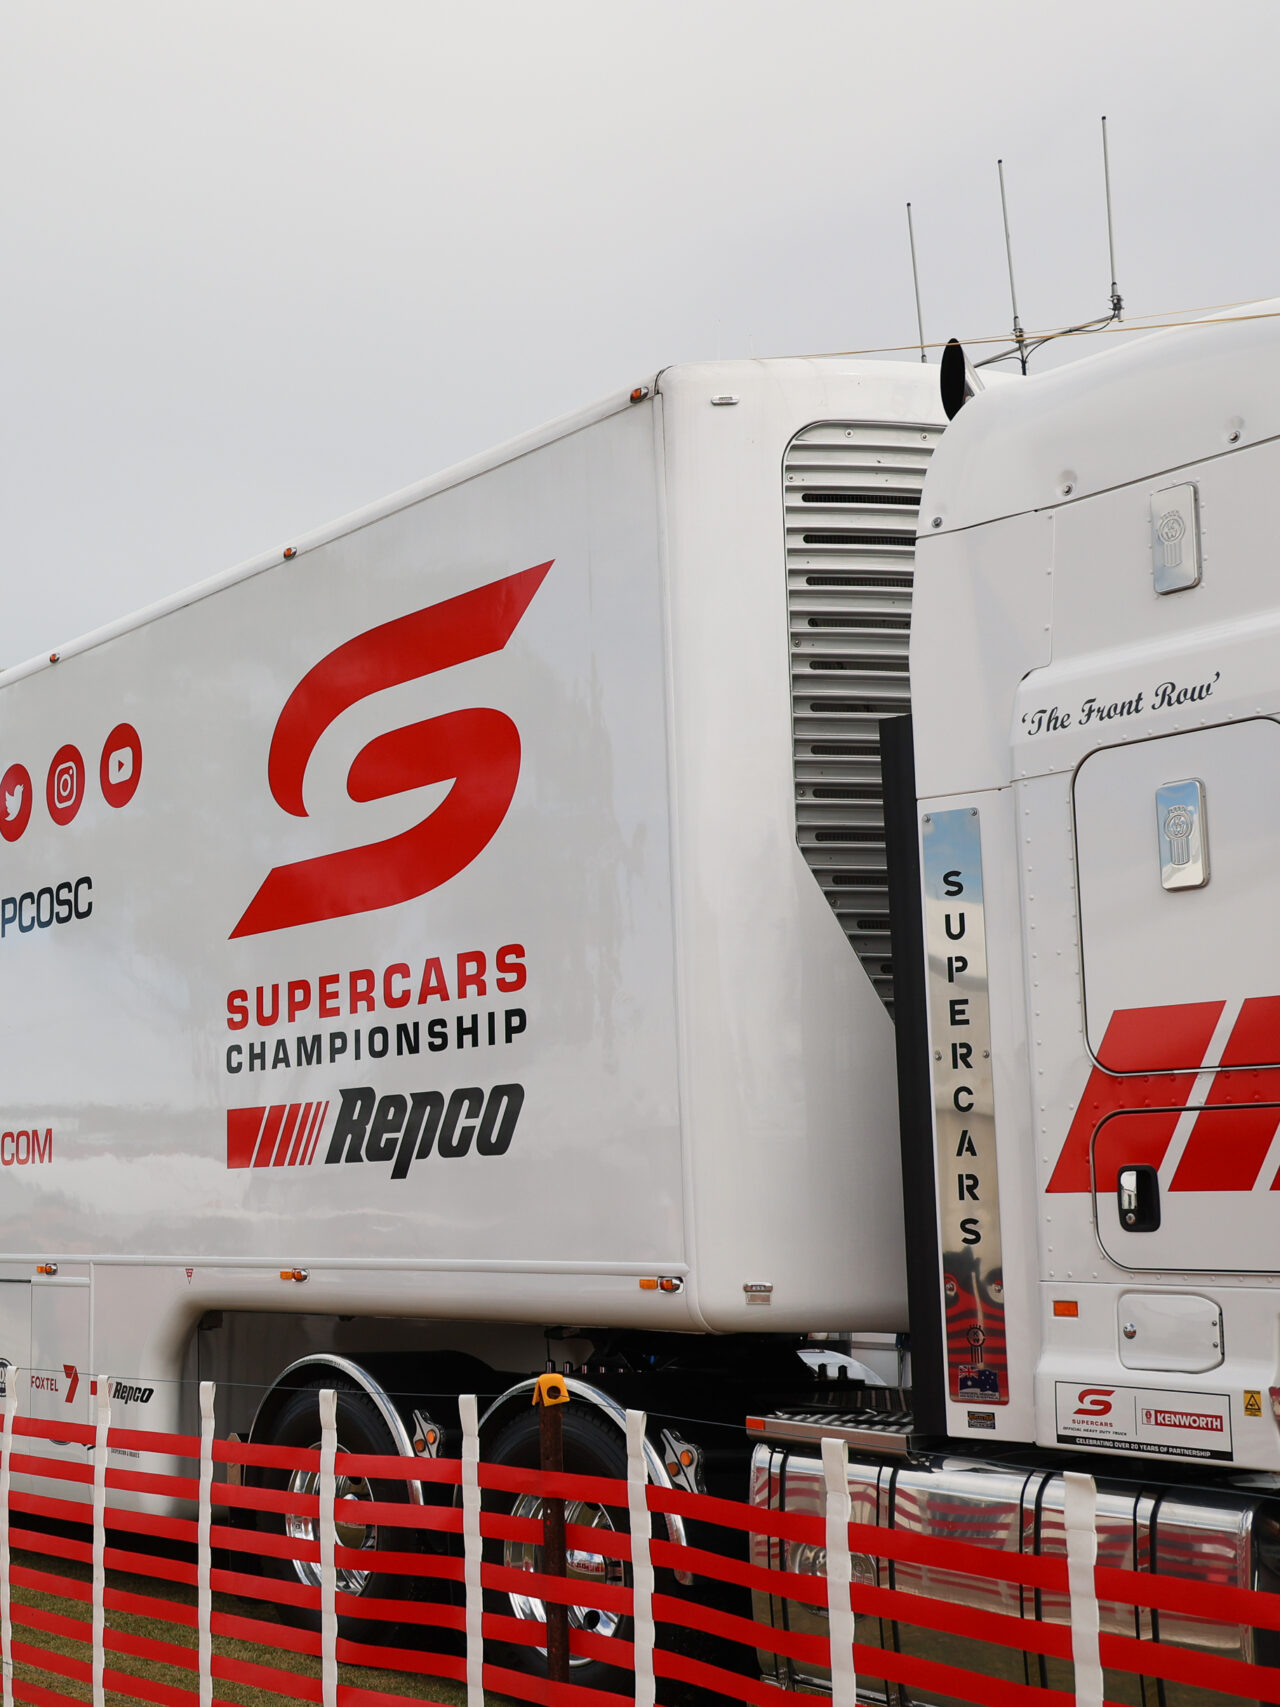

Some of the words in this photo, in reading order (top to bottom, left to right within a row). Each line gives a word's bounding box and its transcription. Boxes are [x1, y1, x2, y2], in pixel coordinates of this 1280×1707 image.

[1079, 691, 1143, 726] Front
[227, 943, 528, 1031] SUPERCARS
[226, 1007, 528, 1075] CHAMPIONSHIP
[942, 870, 981, 1245] SUPERCARS
[324, 1083, 525, 1180] Repco
[30, 1375, 59, 1392] FOXTEL
[112, 1381, 155, 1405] Repco
[1072, 1418, 1114, 1428] SUPERCARS
[1156, 1412, 1222, 1430] KENWORTH
[1075, 1437, 1114, 1447] CELEBRATING
[1114, 1441, 1130, 1449] OVER
[1140, 1443, 1159, 1452] YEARS
[1168, 1447, 1211, 1457] PARTNERSHIP
